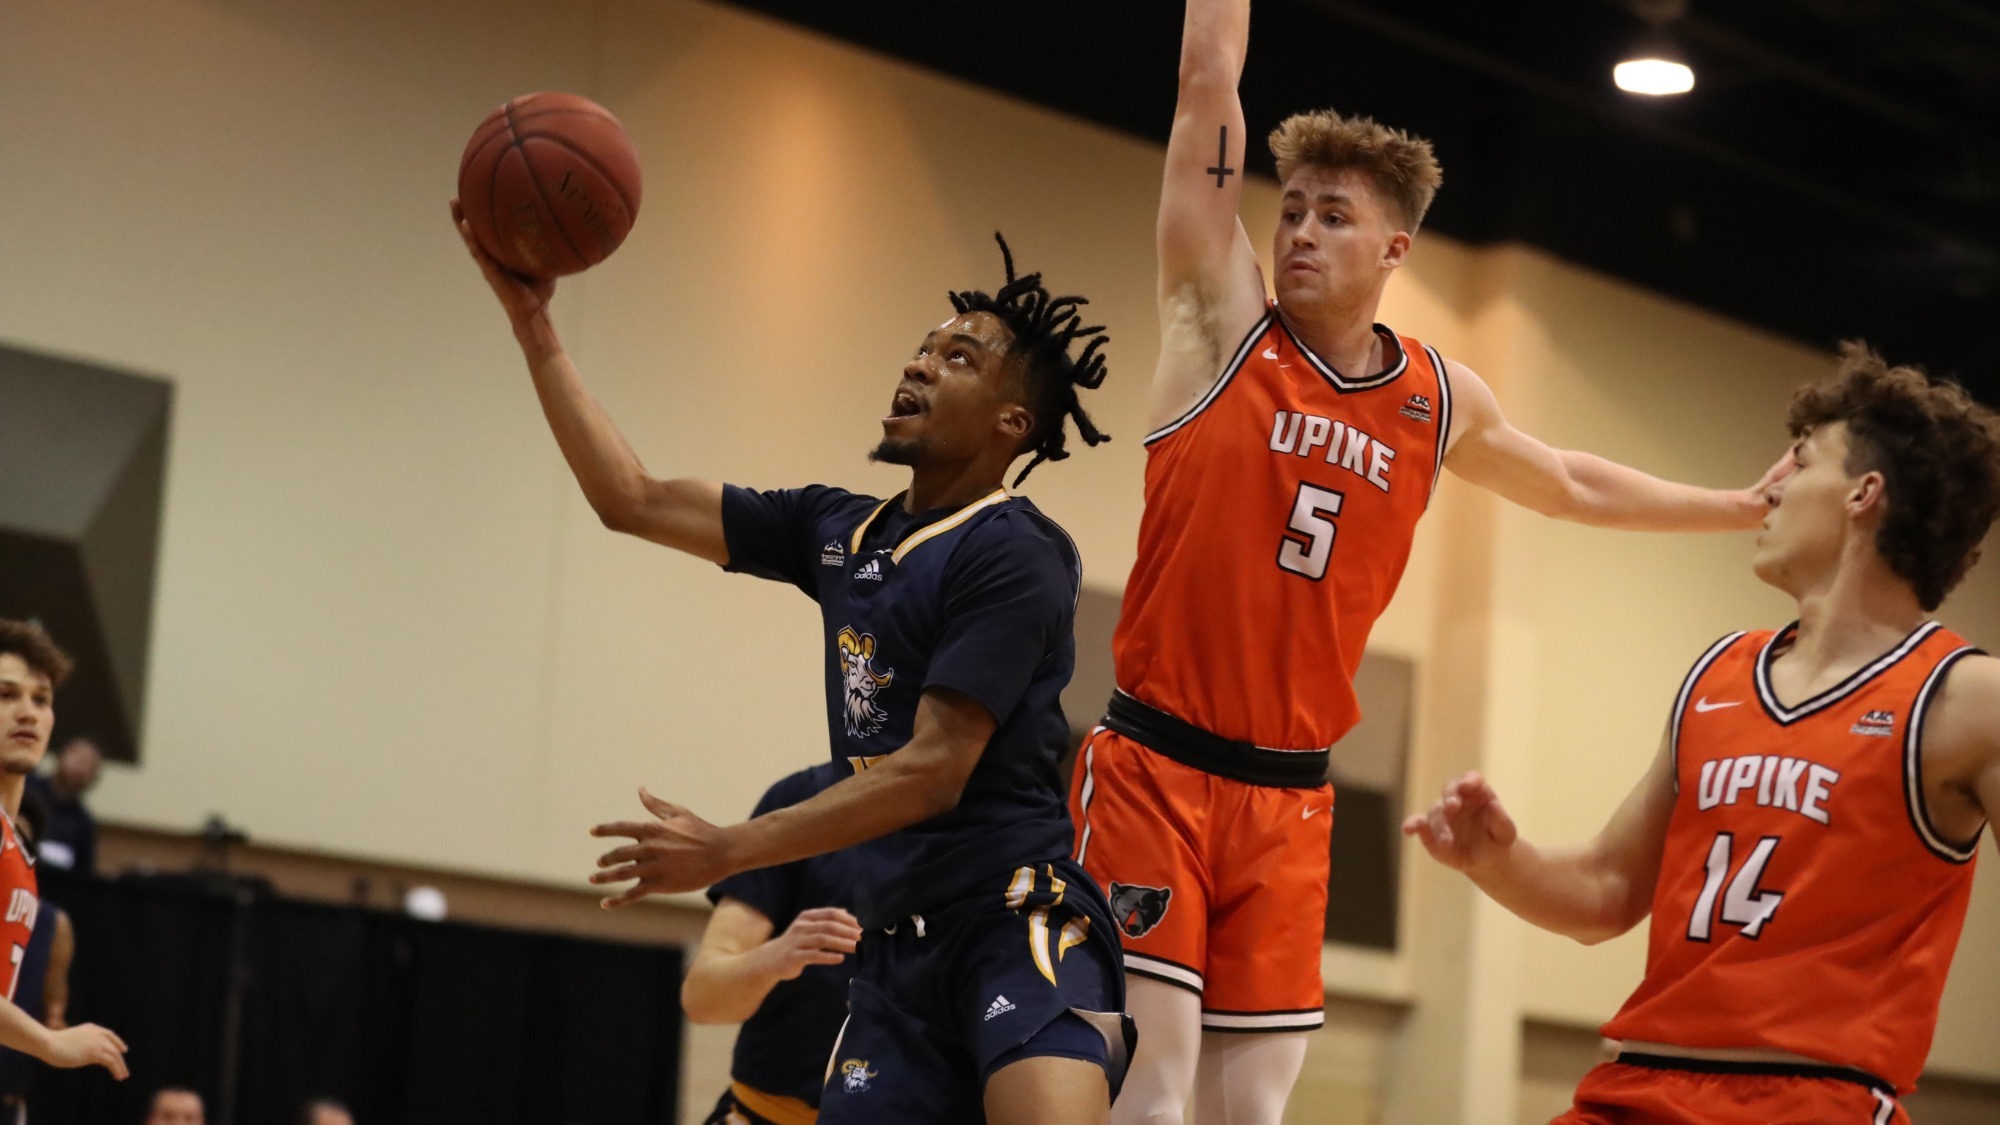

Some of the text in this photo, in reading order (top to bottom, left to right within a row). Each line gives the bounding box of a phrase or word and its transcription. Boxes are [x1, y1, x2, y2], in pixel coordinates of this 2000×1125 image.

[1269, 410, 1397, 494] UPIKE
[1276, 480, 1345, 582] 5
[854, 570, 882, 581] adidas
[1698, 755, 1840, 826] UPIKE
[1686, 831, 1785, 943] 14
[984, 1003, 1016, 1021] adidas
